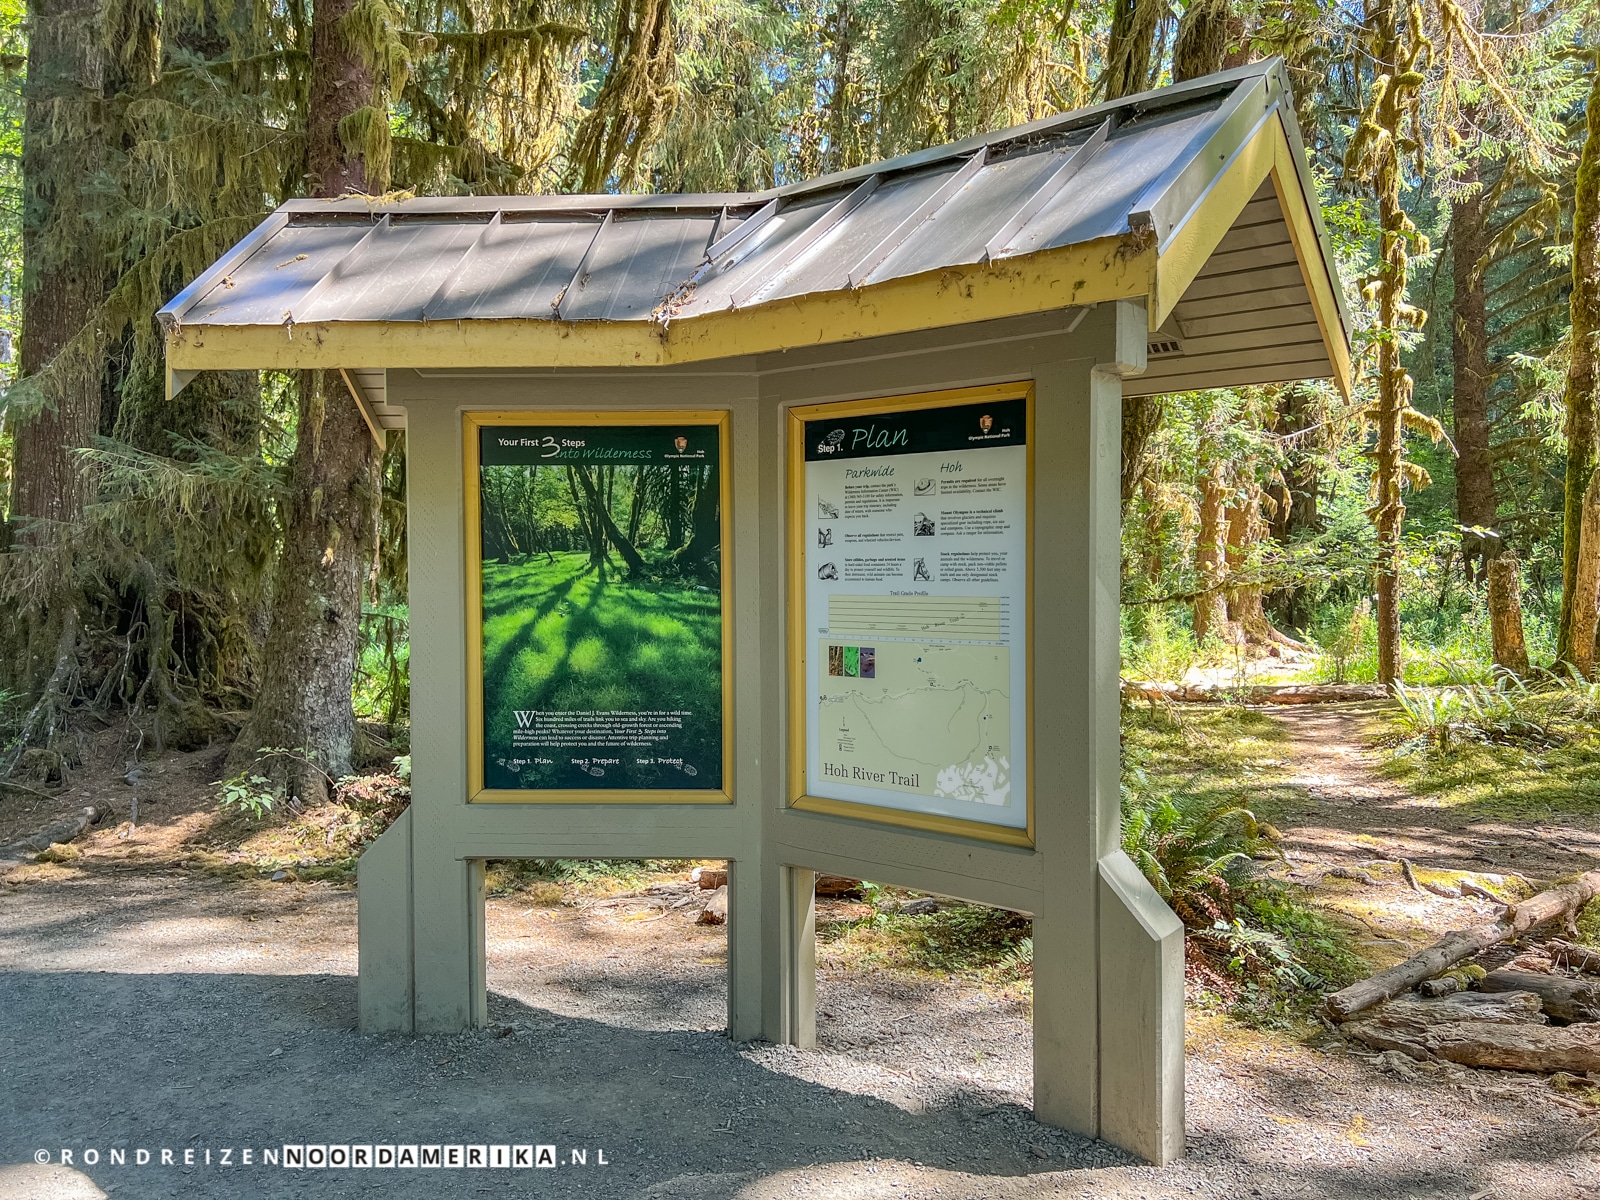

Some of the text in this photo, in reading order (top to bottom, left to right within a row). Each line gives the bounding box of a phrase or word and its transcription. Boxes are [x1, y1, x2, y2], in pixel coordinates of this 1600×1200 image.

[817, 424, 909, 454] Step 1. Plan
[498, 436, 586, 458] Your First 3 Steps
[556, 448, 652, 460] into Wilderness
[845, 464, 895, 479] Parkwide
[940, 460, 963, 473] Hoh
[592, 758, 619, 766] Prepare
[824, 762, 920, 787] Hoh River Trail
